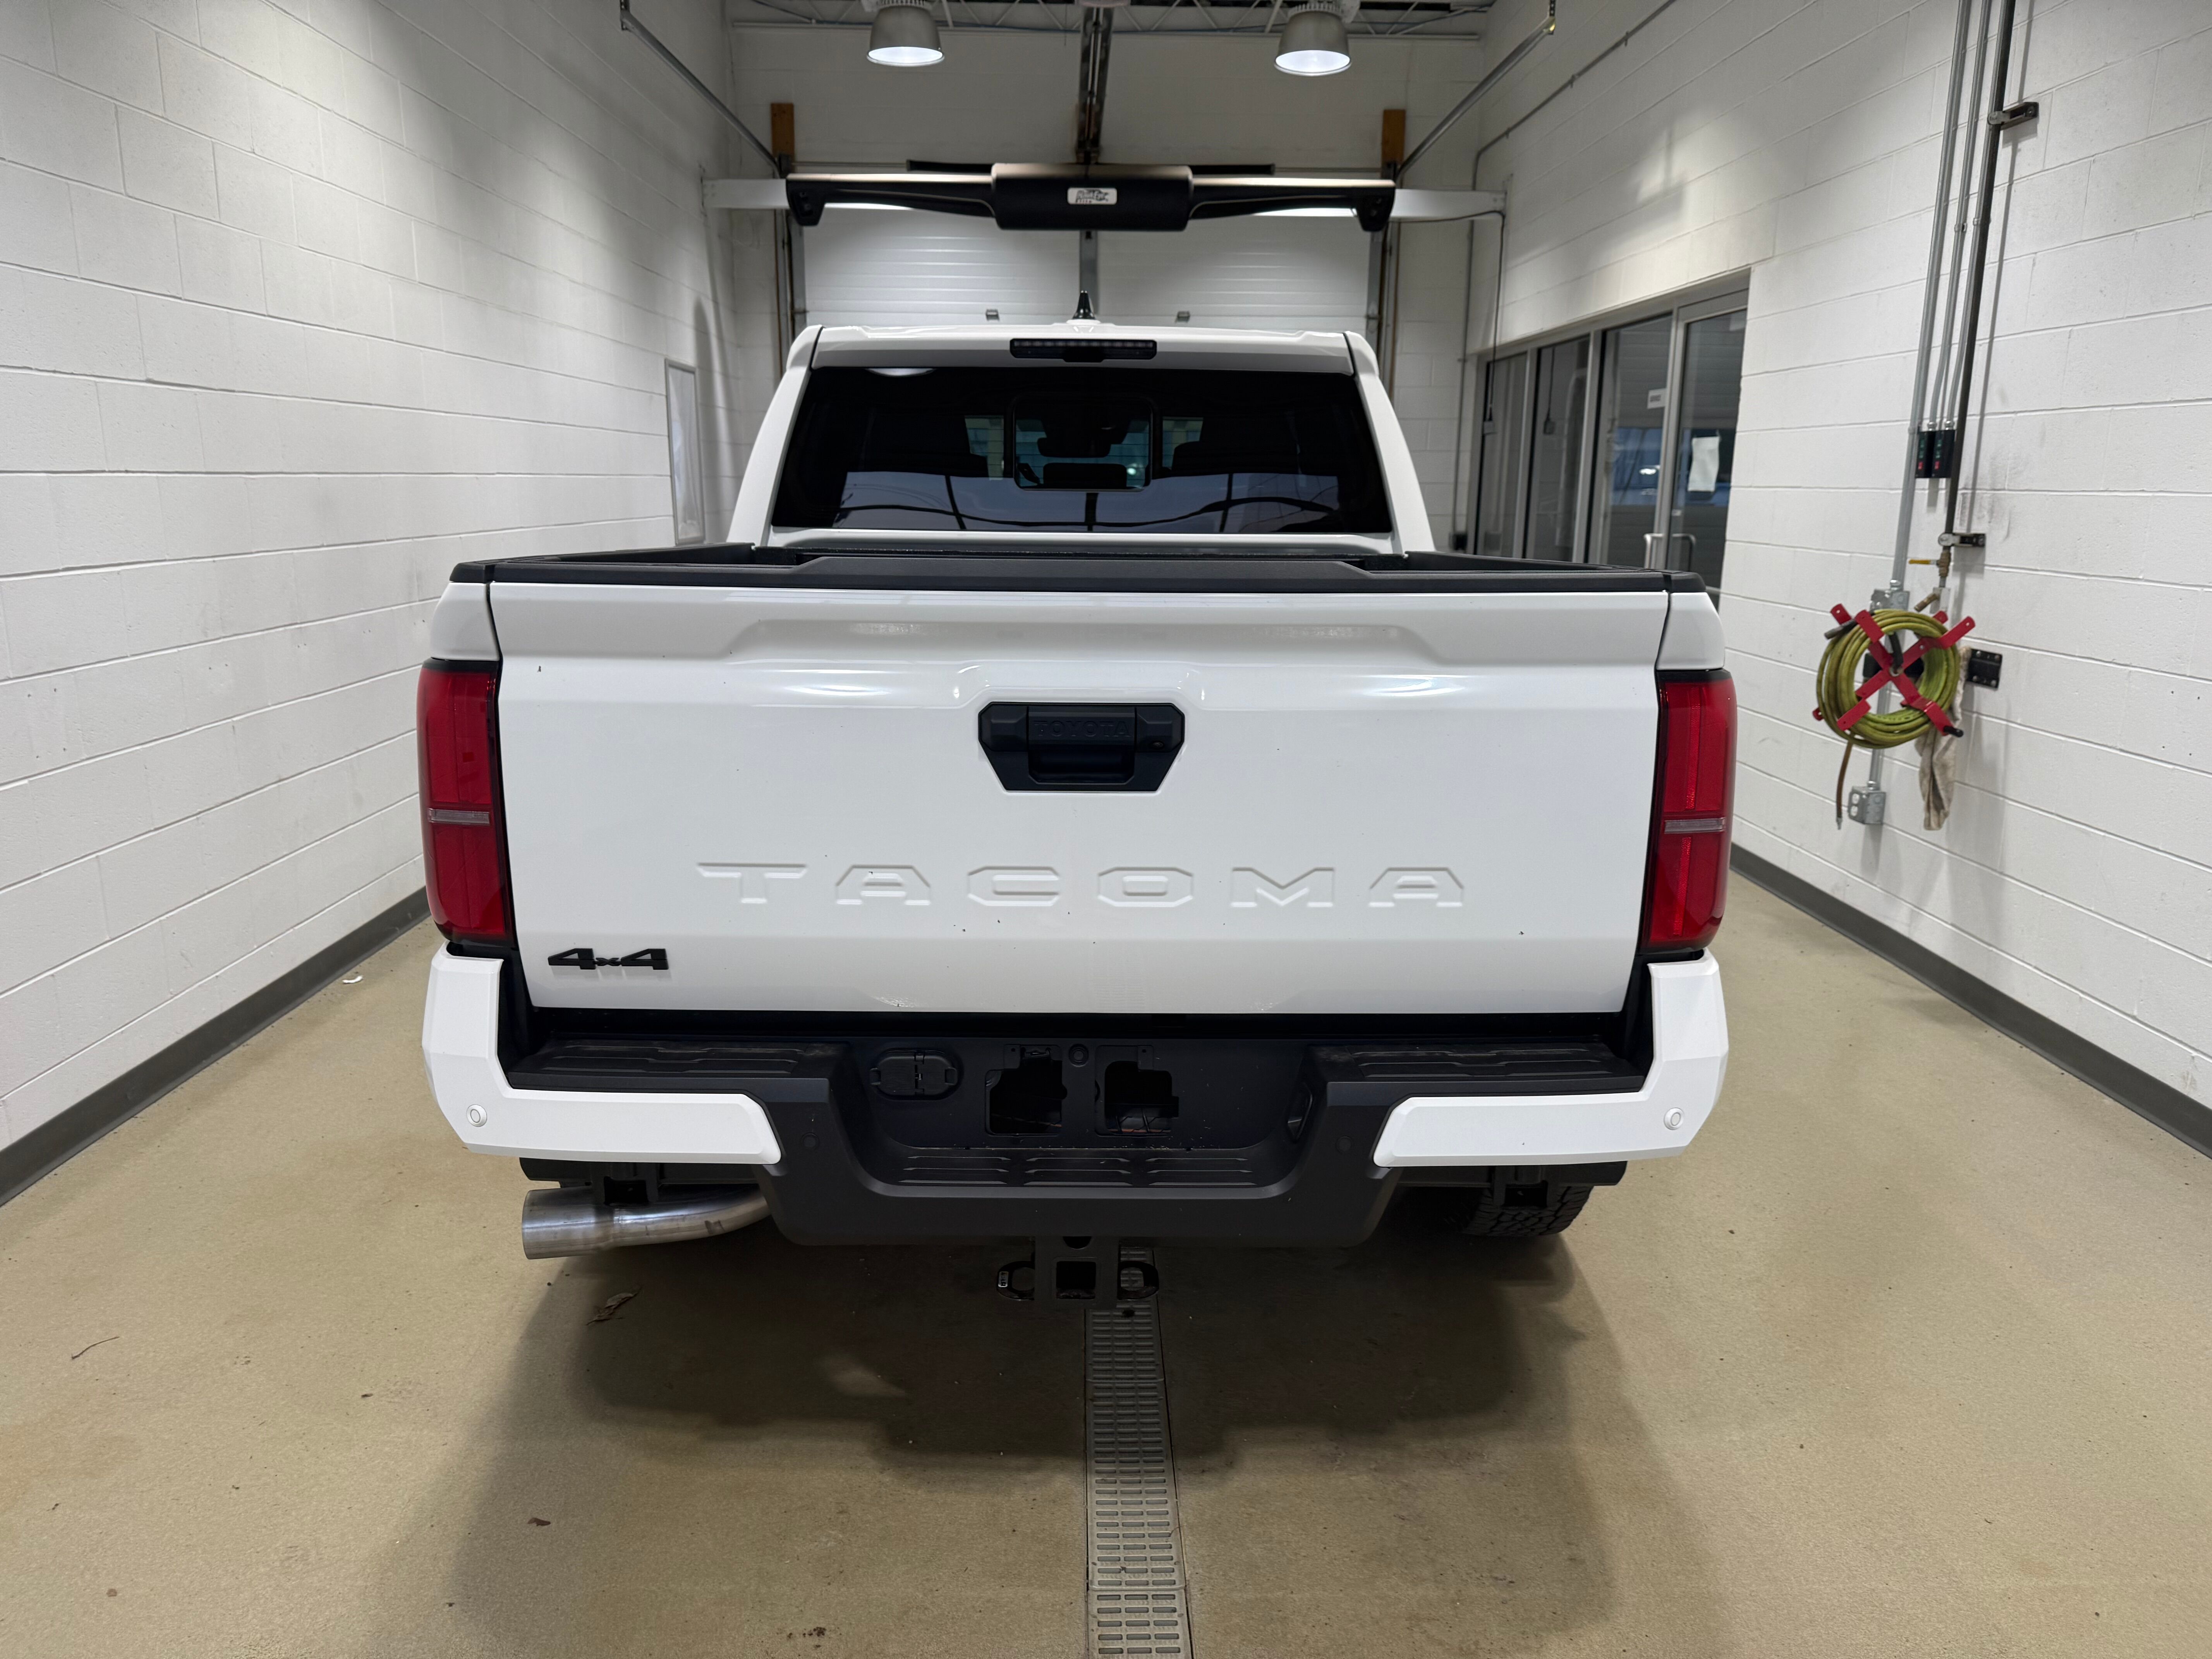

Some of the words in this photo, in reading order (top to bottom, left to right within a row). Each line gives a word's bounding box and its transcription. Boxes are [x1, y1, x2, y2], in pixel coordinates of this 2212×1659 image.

[1032, 720, 1132, 737] TOYOTA
[696, 862, 1464, 907] TACOMA
[548, 948, 669, 970] 4x4
